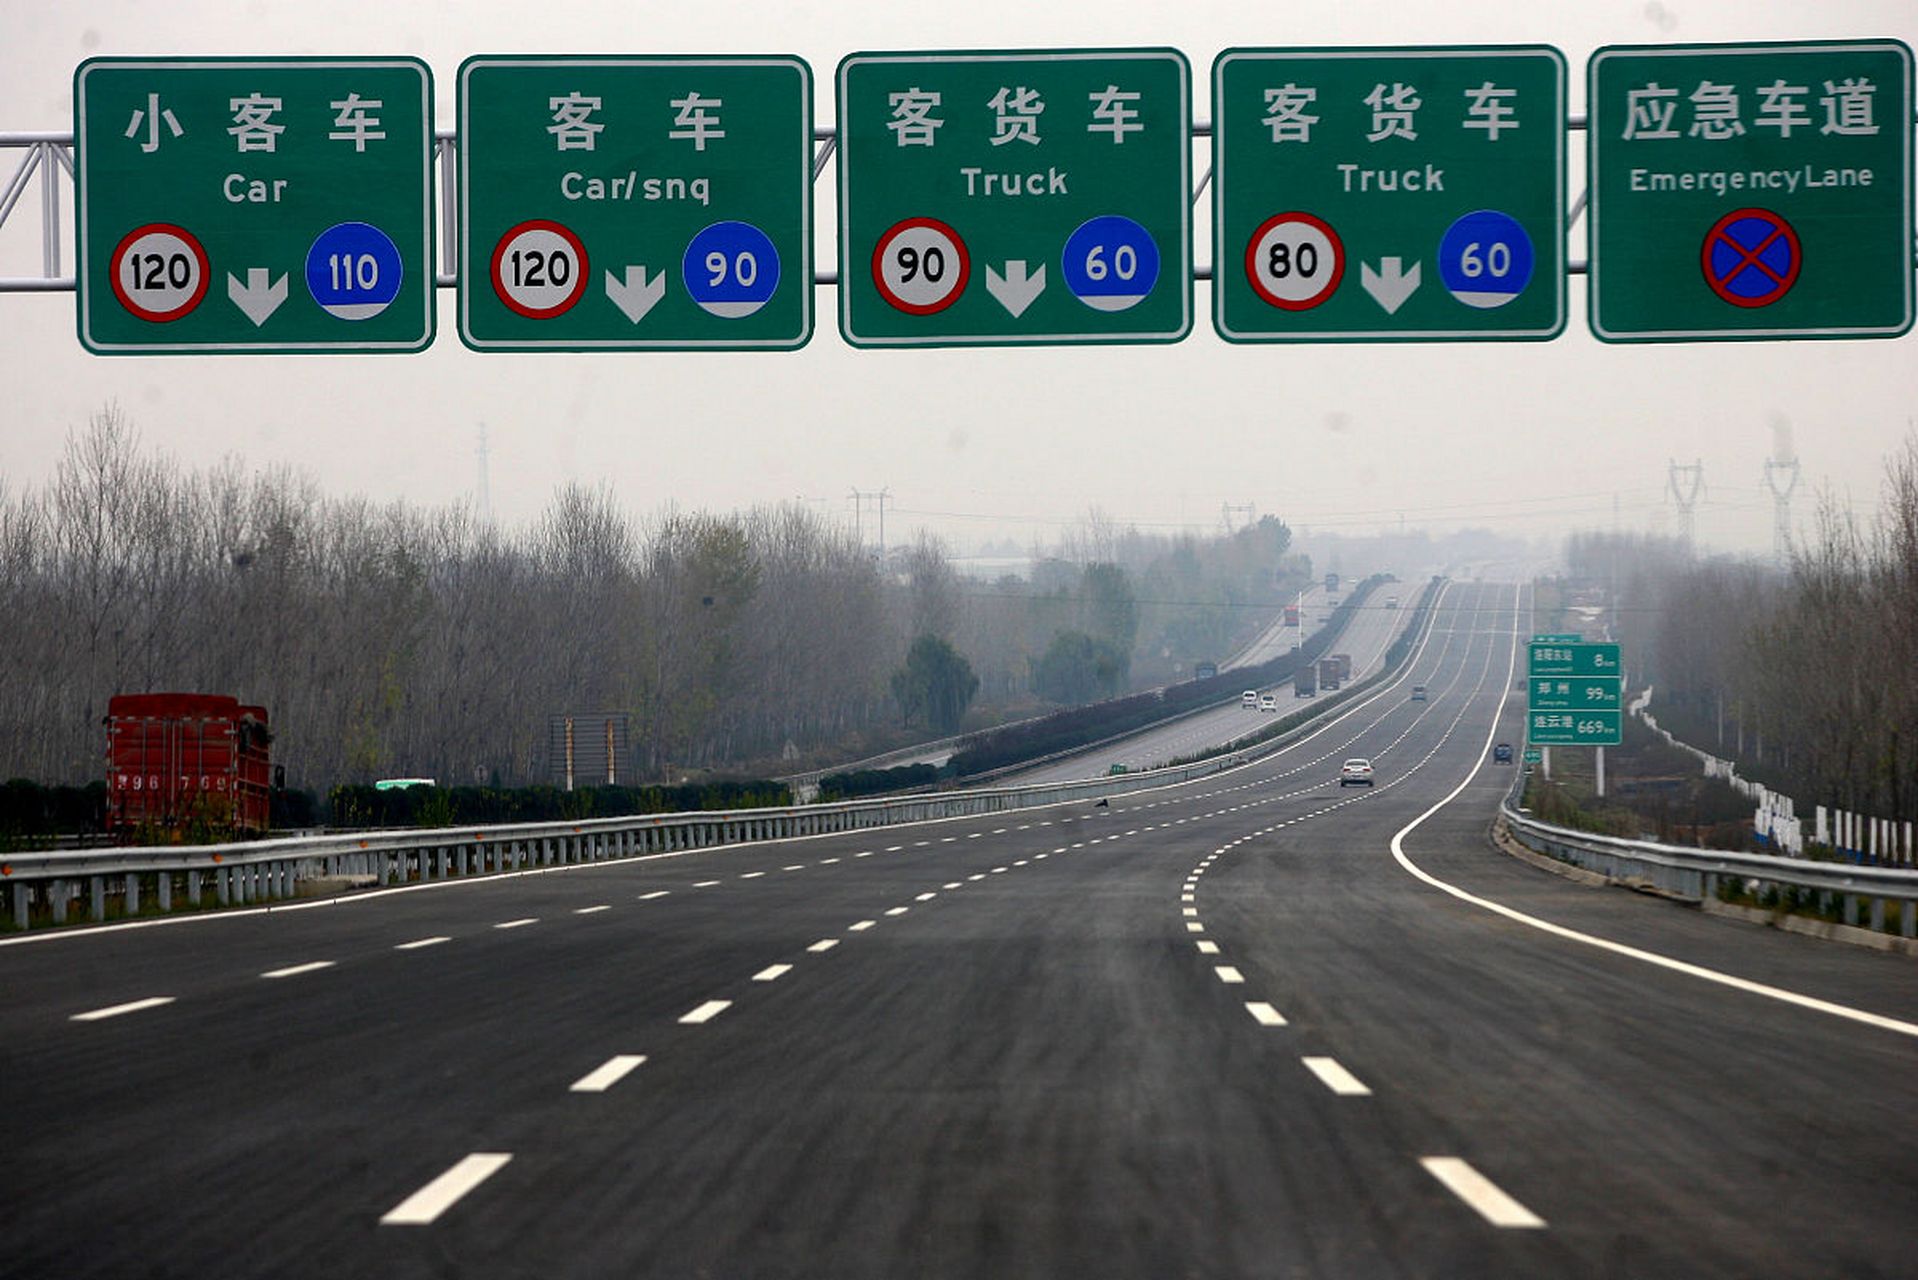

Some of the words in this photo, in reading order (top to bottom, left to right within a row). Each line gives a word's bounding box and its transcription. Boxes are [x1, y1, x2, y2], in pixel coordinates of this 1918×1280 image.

[125, 92, 386, 153] 小客车
[547, 91, 726, 151] 客车
[886, 85, 1144, 147] 客货车
[1261, 82, 1520, 143] 客货车
[1622, 77, 1880, 140] 应急车道
[223, 173, 287, 203] Car
[961, 167, 1068, 196] Truck
[1337, 163, 1445, 192] Truck
[131, 253, 191, 291] 120
[329, 253, 378, 291] 110
[510, 250, 571, 288] 120
[705, 251, 758, 287] 90
[897, 246, 945, 284] 90
[1085, 245, 1138, 281] 60
[1268, 242, 1319, 279] 80
[1461, 241, 1510, 278] 60
